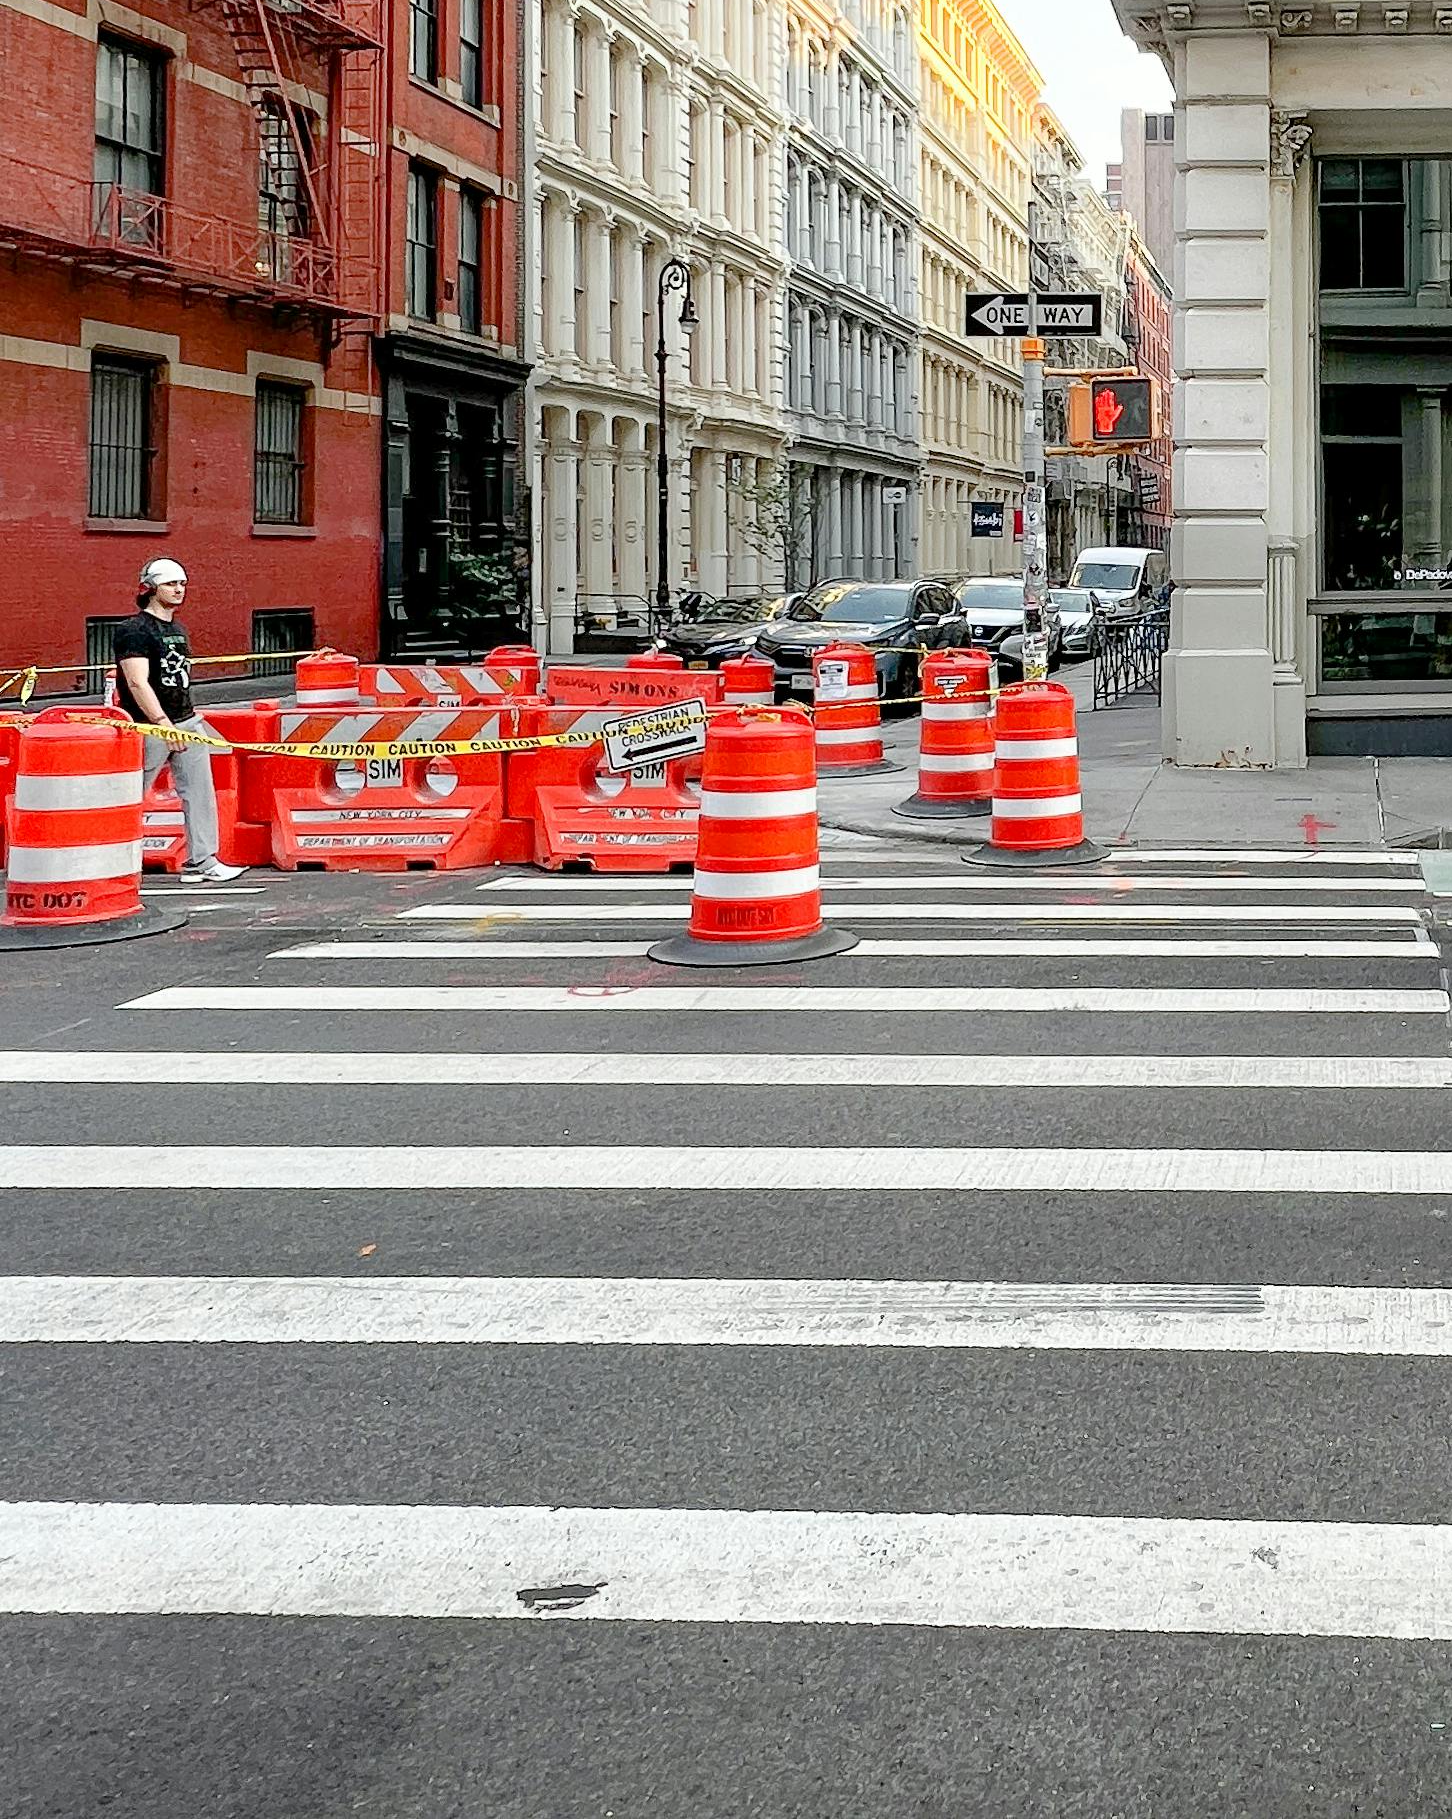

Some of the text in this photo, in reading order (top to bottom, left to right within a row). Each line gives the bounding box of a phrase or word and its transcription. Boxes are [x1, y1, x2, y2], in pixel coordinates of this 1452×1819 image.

[986, 307, 1084, 324] ONE WAY
[608, 680, 680, 698] SIMONS
[309, 744, 376, 757] CAUTION
[388, 743, 457, 756] CAUTION
[470, 738, 542, 752] CAUTION
[555, 727, 629, 745] CAUTION
[368, 759, 401, 780] SIM
[338, 810, 423, 820] NEW YORK CITY
[43, 891, 87, 909] DOT
